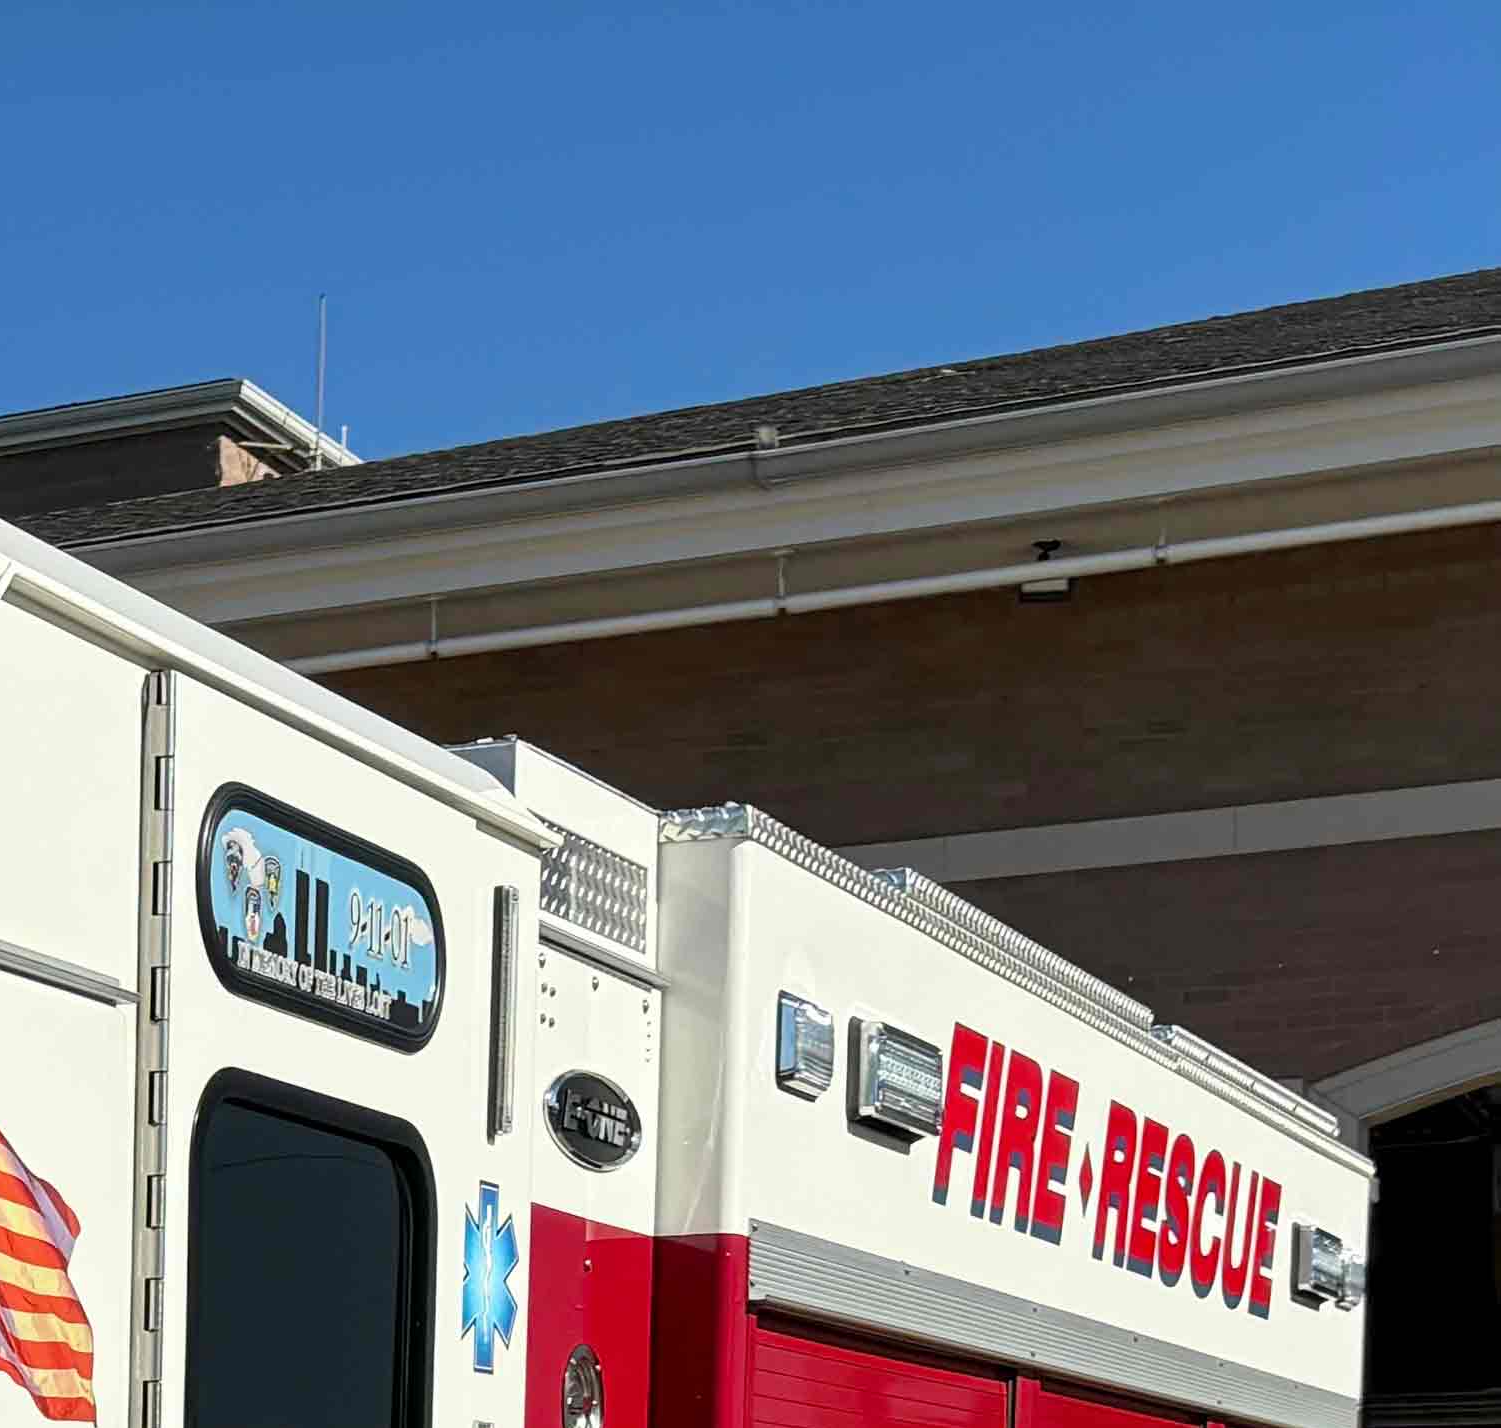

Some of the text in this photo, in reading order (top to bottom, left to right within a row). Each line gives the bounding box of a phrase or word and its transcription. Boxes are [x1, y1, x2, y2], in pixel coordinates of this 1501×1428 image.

[349, 891, 412, 969] 9-11-01
[299, 963, 314, 992] OF
[314, 969, 336, 1000] THE
[932, 1022, 1282, 1320] FIRE RESCUE
